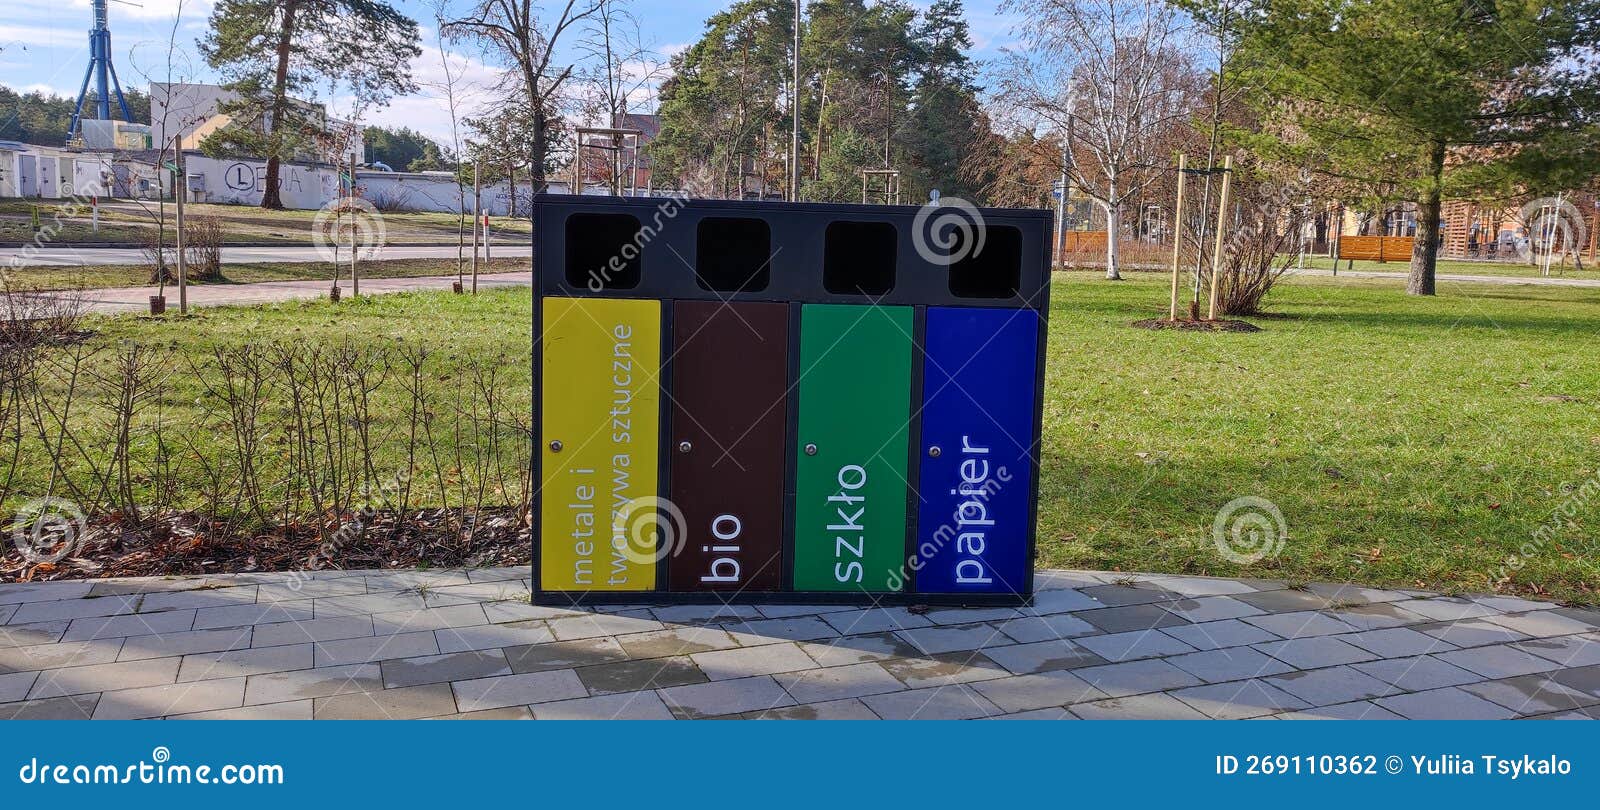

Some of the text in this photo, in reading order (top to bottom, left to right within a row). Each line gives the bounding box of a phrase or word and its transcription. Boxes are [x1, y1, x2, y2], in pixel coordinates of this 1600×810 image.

[607, 323, 634, 585] tworzywa sztuczne
[950, 435, 996, 584] papier
[568, 484, 595, 584] metale
[700, 514, 742, 582] bio
[825, 464, 868, 583] szkło
